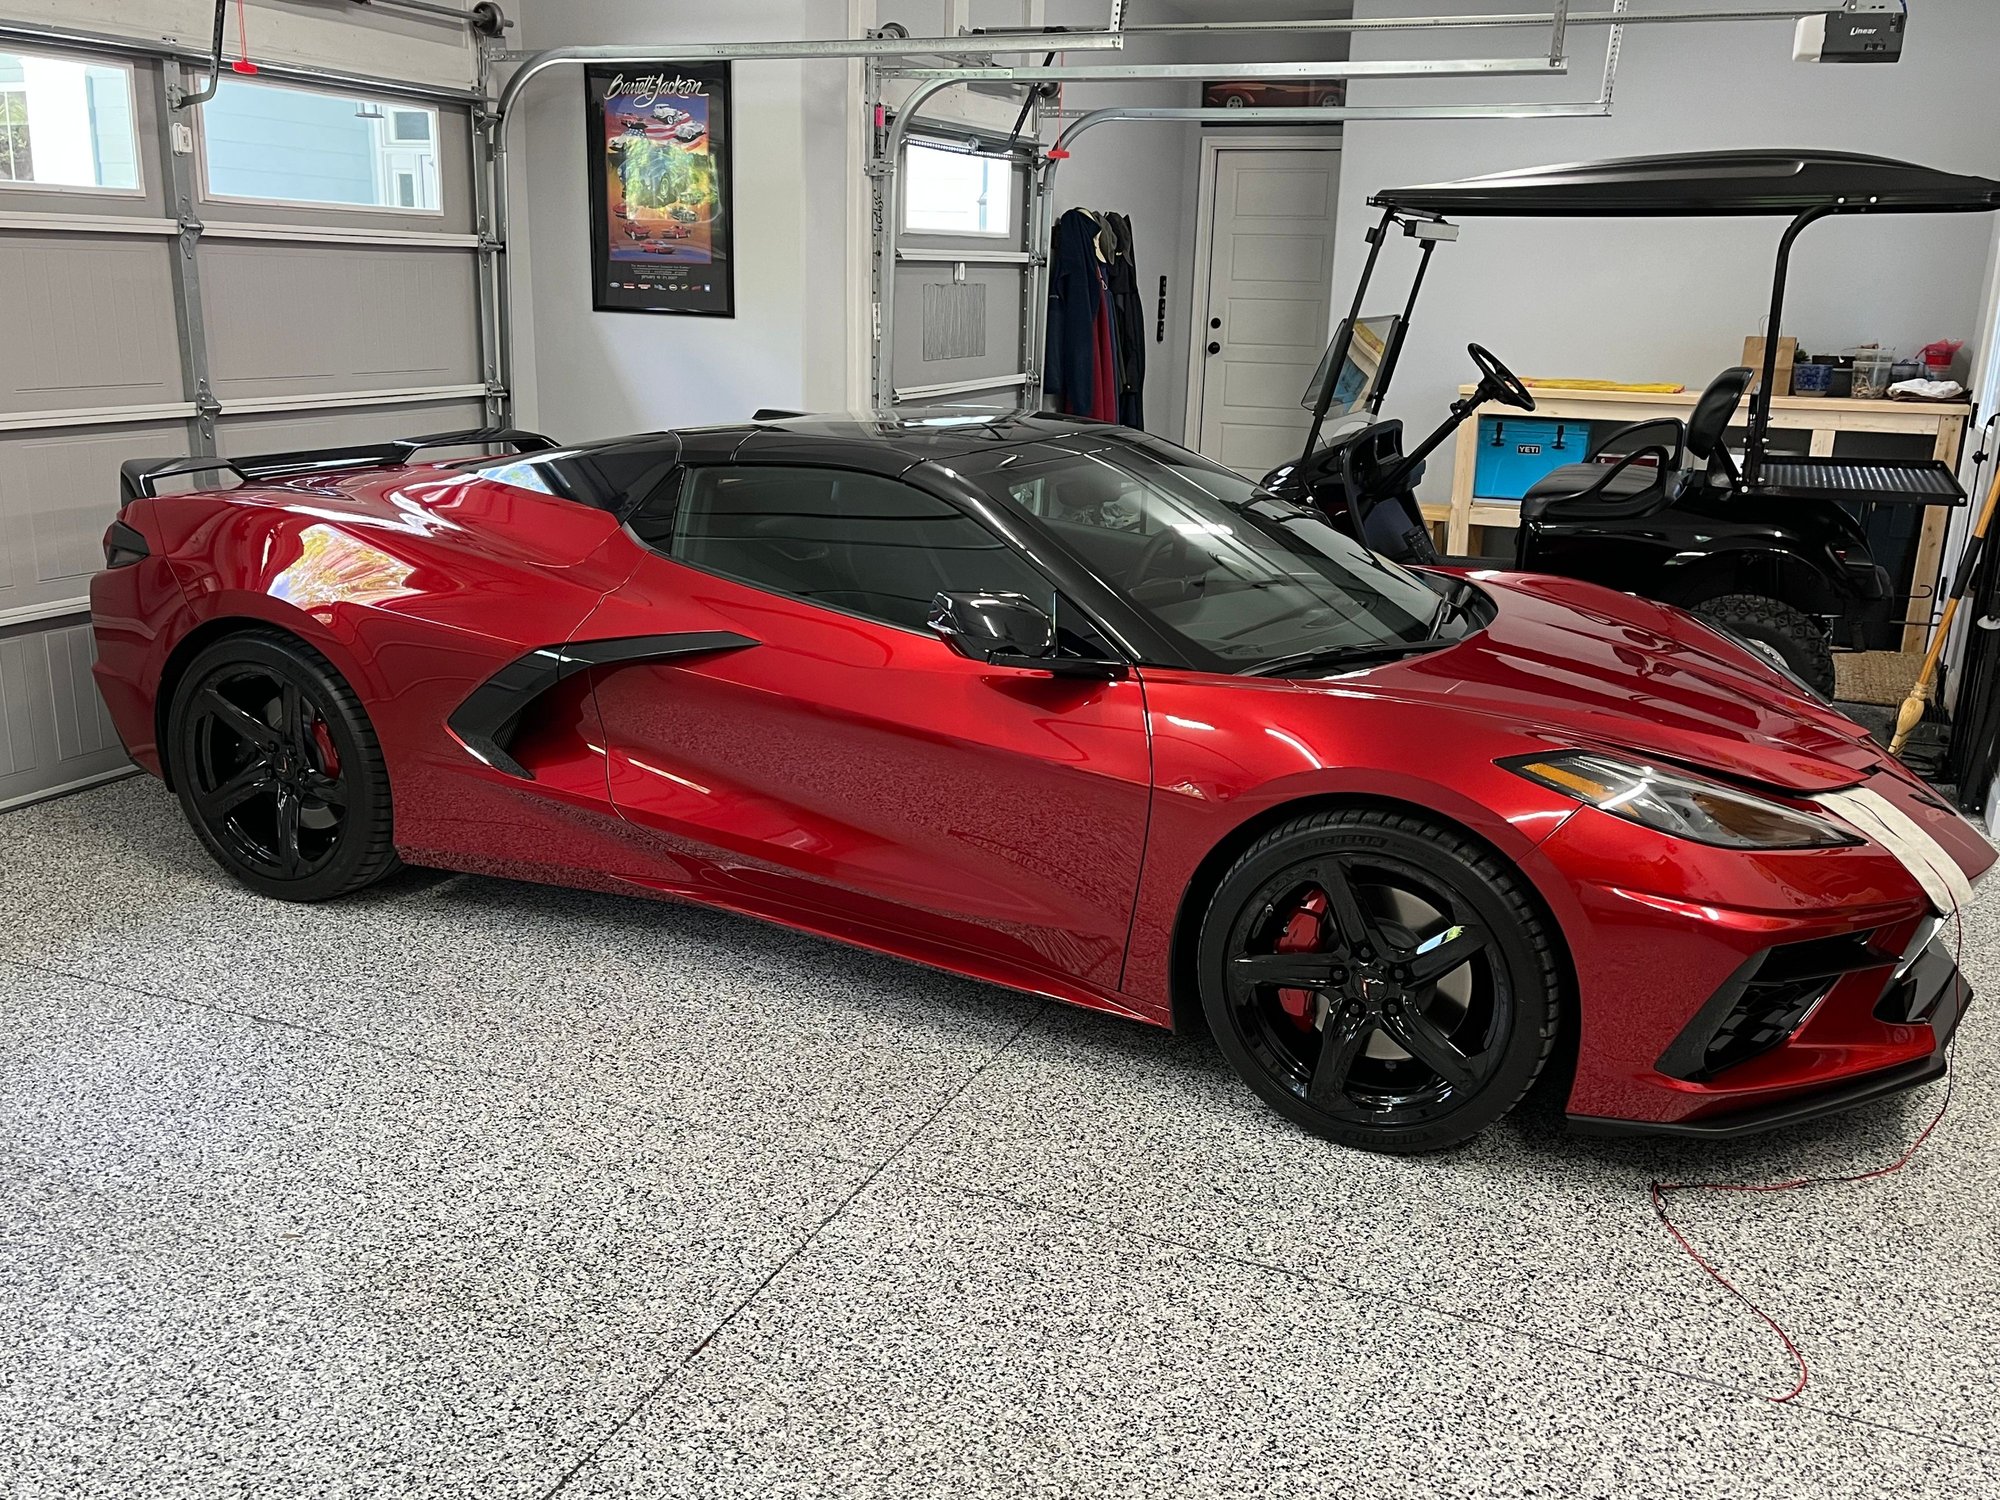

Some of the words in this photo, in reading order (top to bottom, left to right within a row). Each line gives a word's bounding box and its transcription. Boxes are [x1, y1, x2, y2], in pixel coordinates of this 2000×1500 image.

[1850, 27, 1877, 36] Linear
[603, 73, 709, 108] Barrett-Jackson
[1303, 835, 1383, 850] MICHELIN
